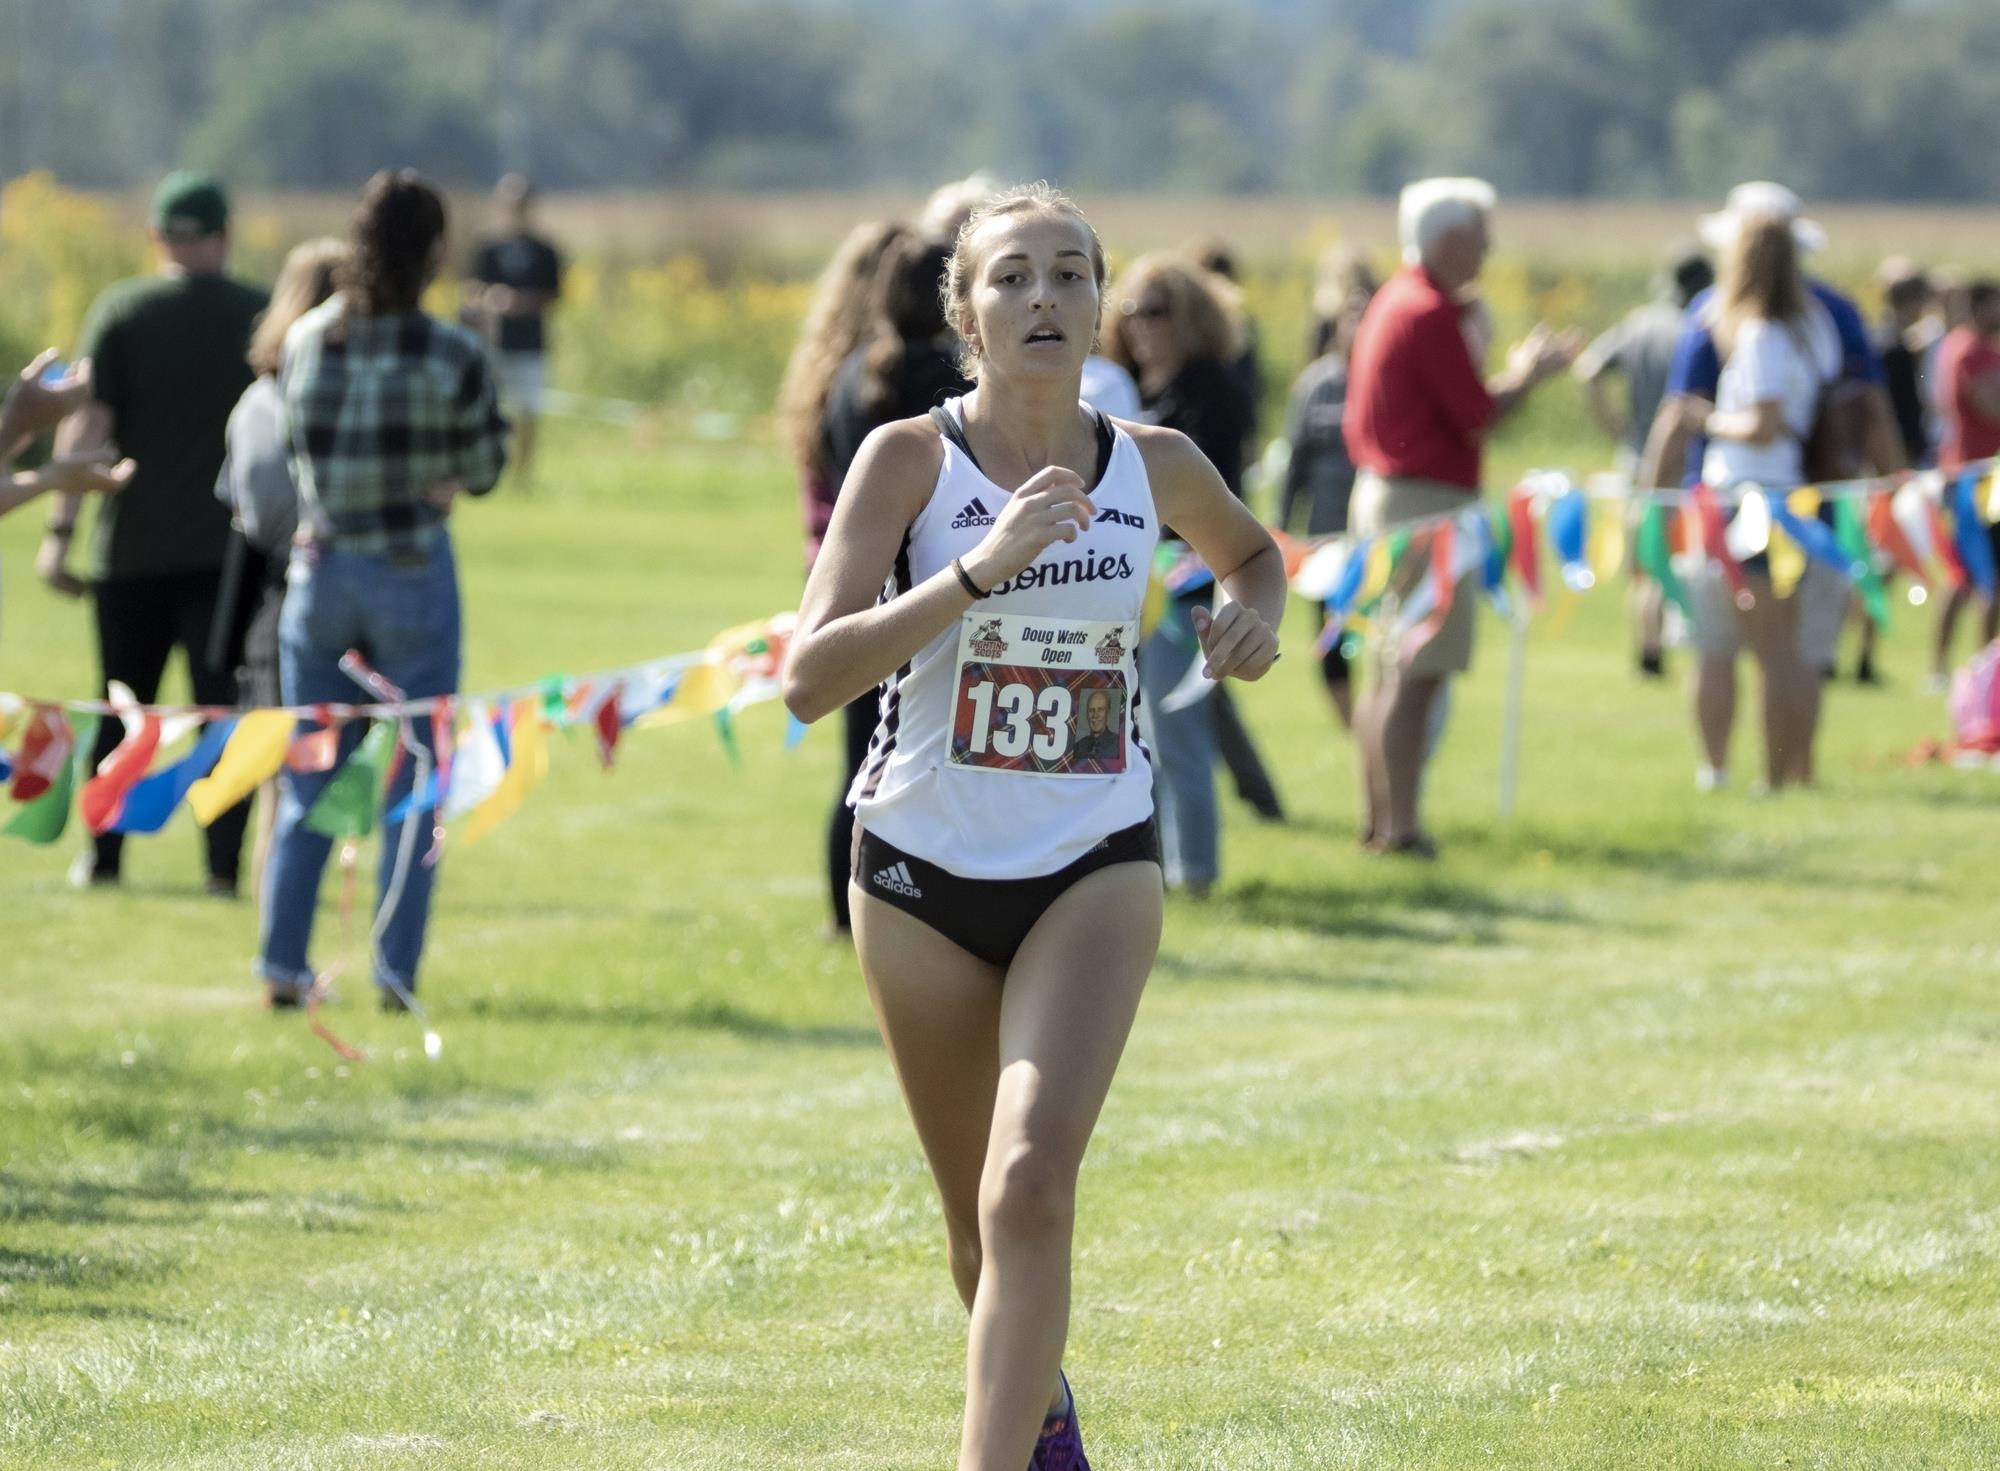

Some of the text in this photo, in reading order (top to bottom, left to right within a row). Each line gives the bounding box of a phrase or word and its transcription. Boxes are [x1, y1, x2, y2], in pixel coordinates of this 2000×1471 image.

[951, 515, 997, 529] adidas
[1021, 627, 1088, 645] Doug Watts
[968, 639, 1008, 651] FIGHTING
[1041, 648, 1072, 664] Open
[967, 680, 1072, 761] 133
[873, 873, 922, 899] adidas
